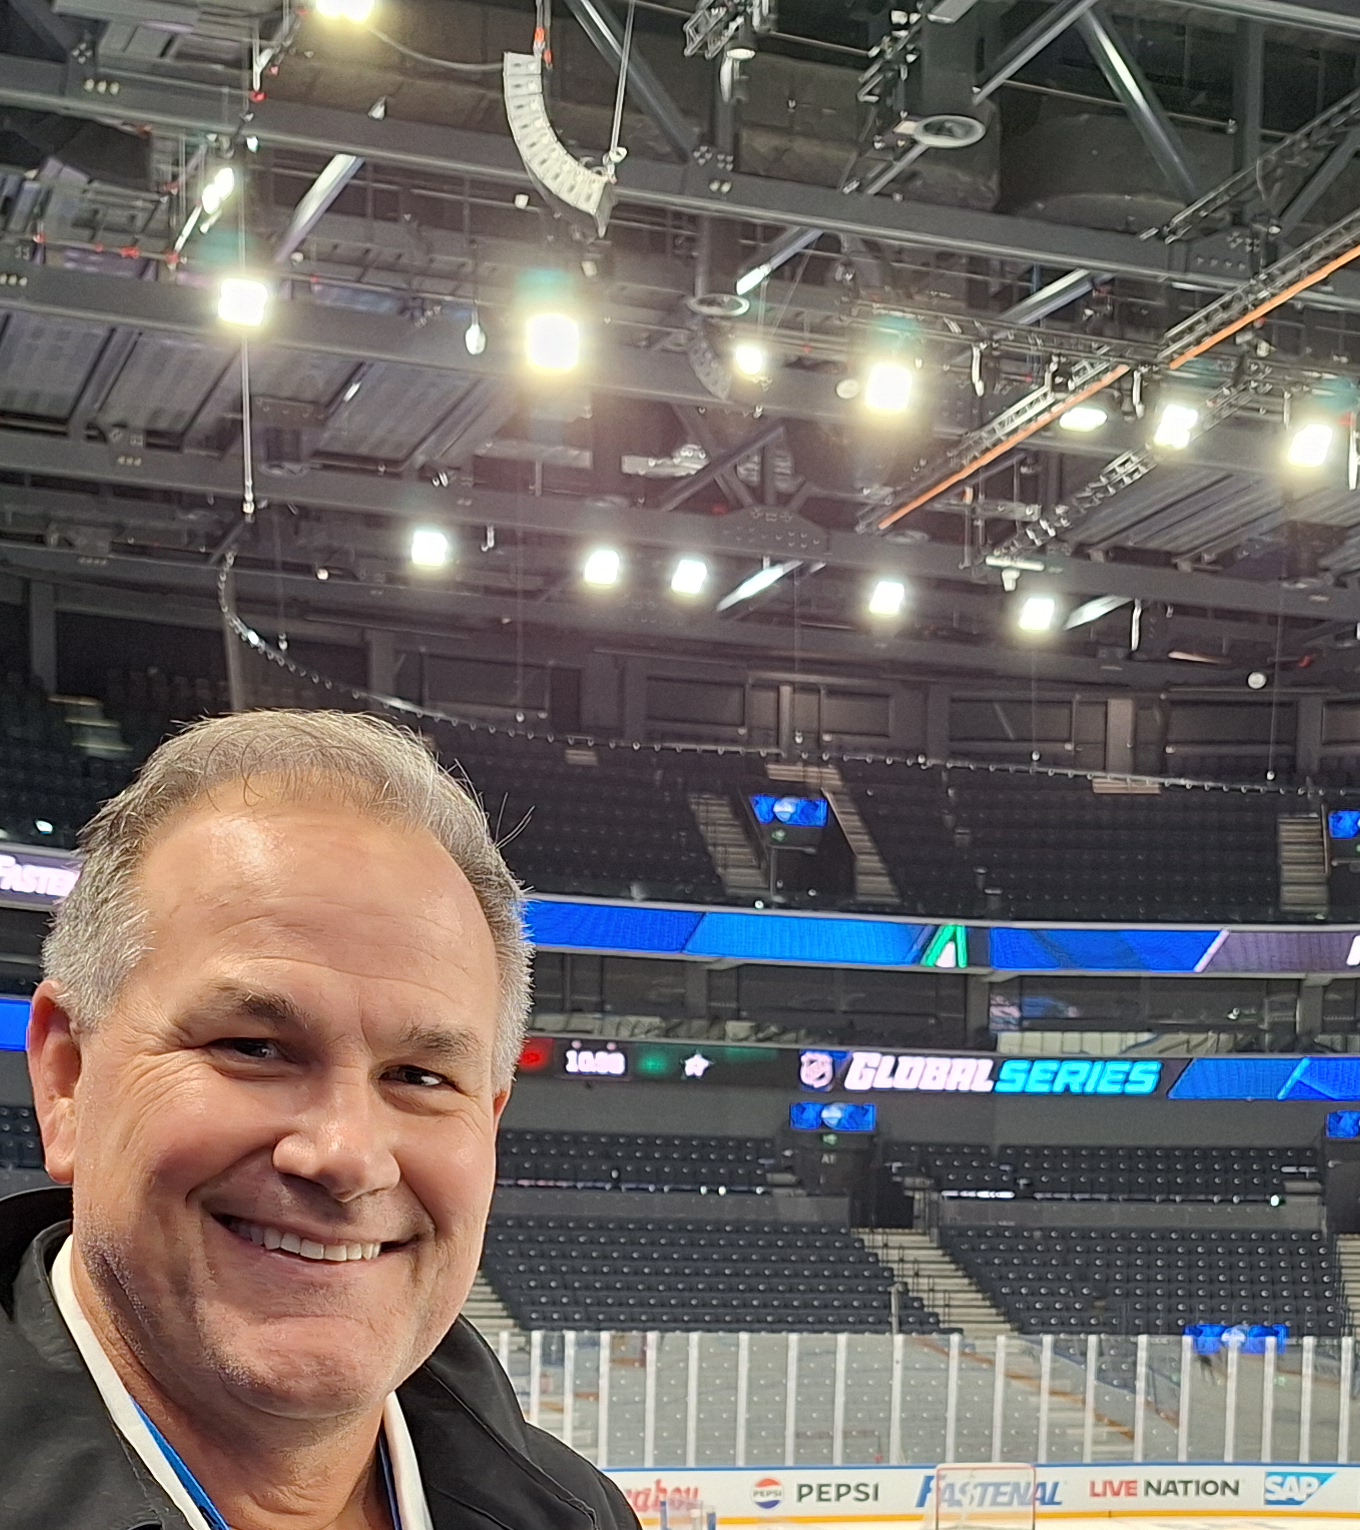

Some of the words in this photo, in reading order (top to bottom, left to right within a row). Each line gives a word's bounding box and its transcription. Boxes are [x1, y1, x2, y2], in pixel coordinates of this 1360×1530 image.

[844, 1051, 994, 1093] GLOBAL
[994, 1059, 1163, 1094] SERIES
[752, 1489, 783, 1498] PEPSI
[796, 1483, 879, 1502] PEPSI
[915, 1474, 1063, 1508] FASTENAL
[1089, 1479, 1138, 1498] LIVE
[1144, 1479, 1240, 1497] NATION
[1264, 1475, 1321, 1502] SAP
